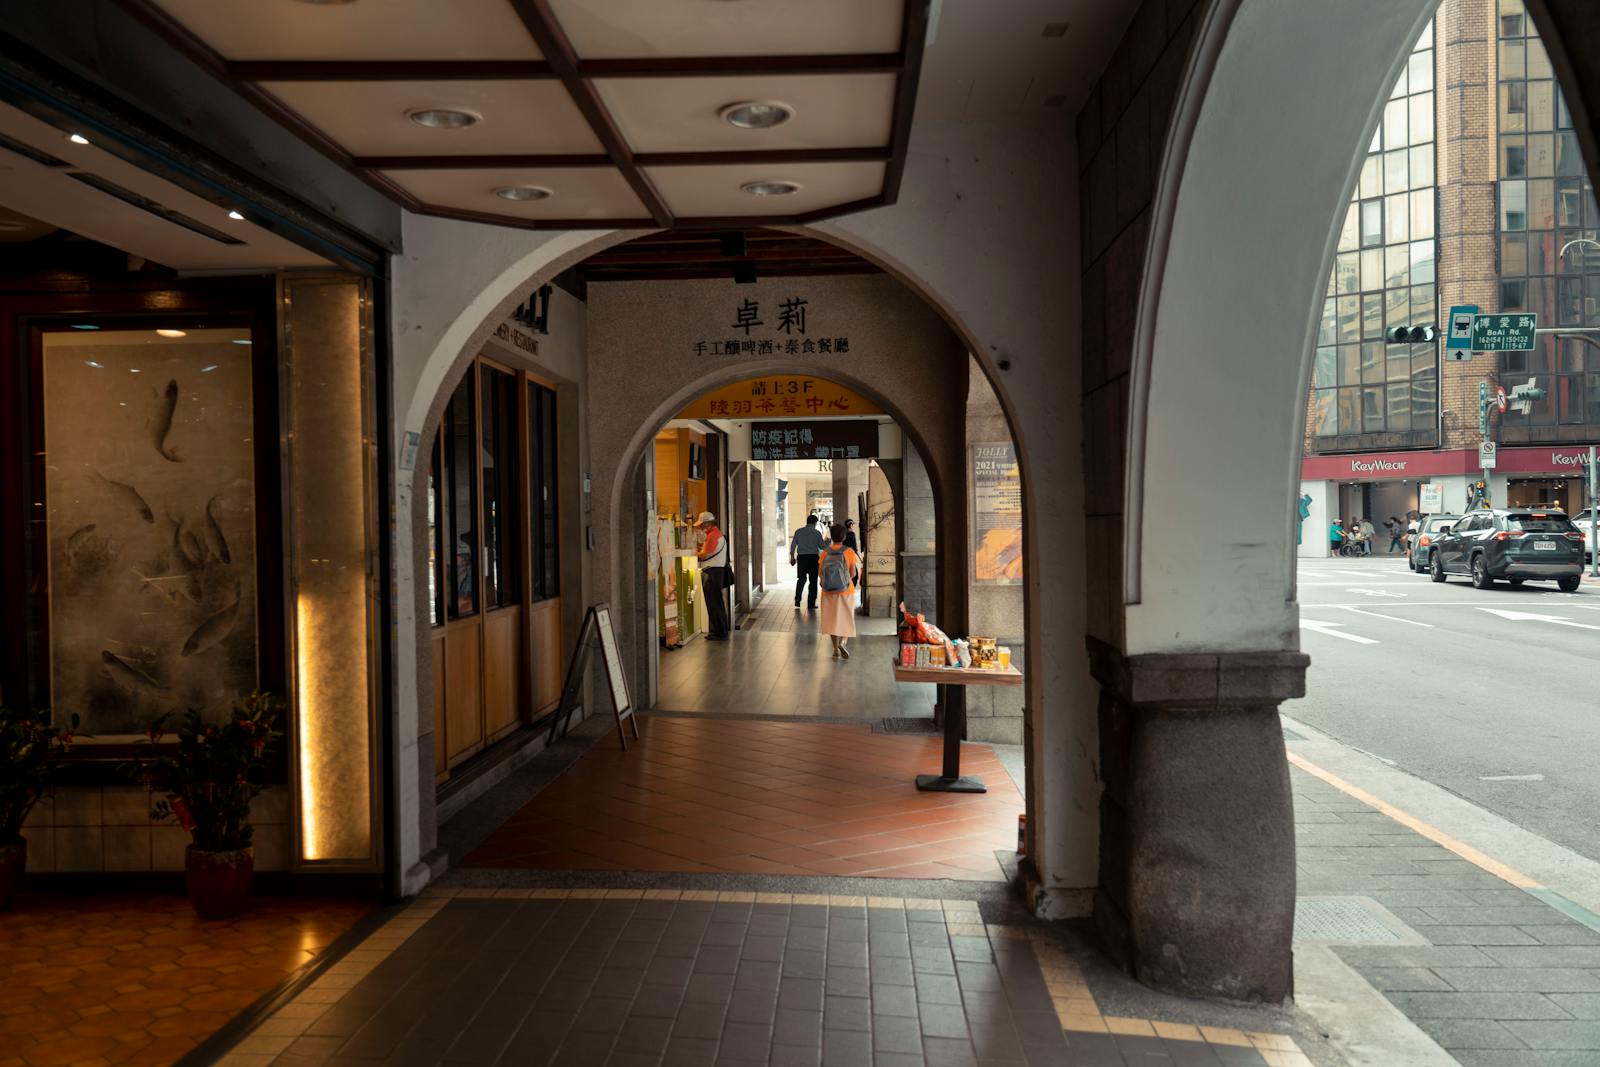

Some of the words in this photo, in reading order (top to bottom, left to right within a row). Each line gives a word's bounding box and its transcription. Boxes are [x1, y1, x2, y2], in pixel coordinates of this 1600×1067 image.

[731, 297, 809, 335] 卓莉
[1479, 316, 1530, 329] 博愛路
[1509, 328, 1521, 336] Rd.
[710, 396, 850, 415] 陸羽茶藝中心
[976, 461, 995, 470] 2021
[1351, 460, 1407, 474] KeyWear
